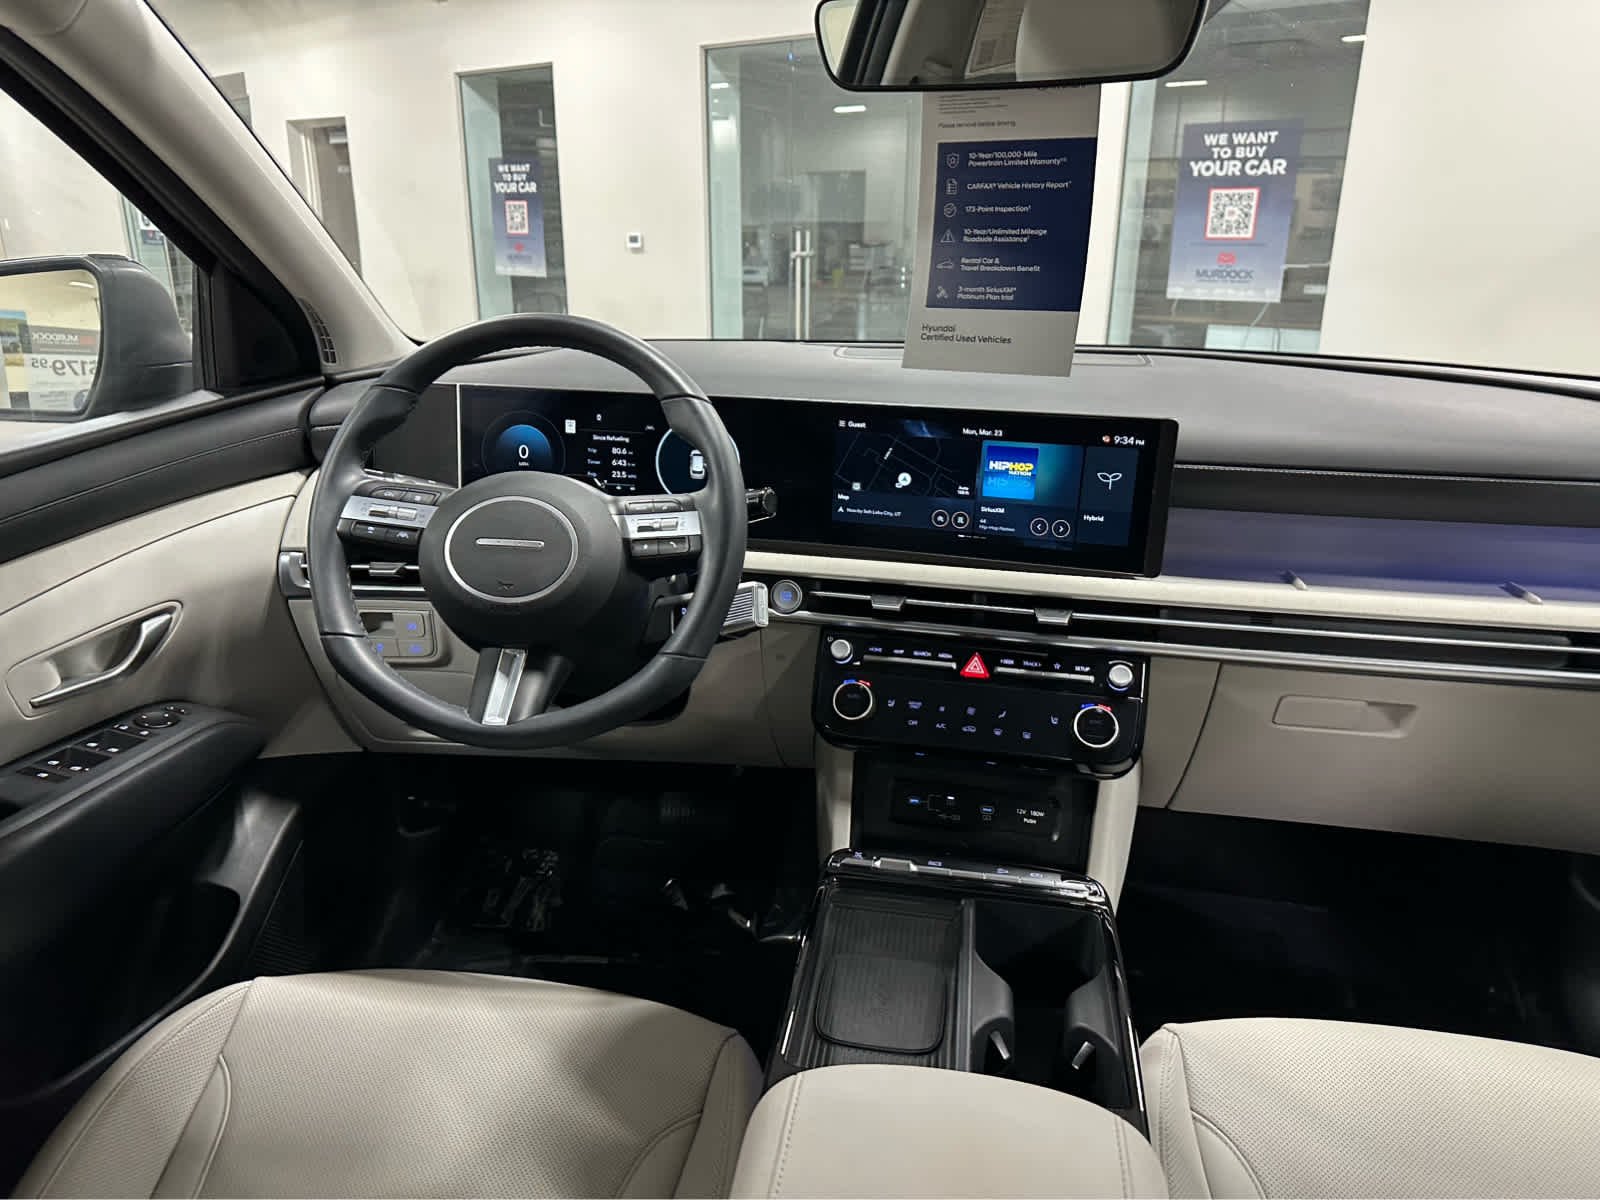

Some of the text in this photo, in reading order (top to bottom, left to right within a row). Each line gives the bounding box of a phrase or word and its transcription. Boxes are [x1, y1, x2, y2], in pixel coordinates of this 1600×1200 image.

[1204, 131, 1279, 146] WE WANT
[1212, 146, 1268, 159] TO BUY
[1189, 159, 1288, 177] YOUR CAR
[494, 181, 538, 193] YOUR CAR
[1020, 227, 1048, 237] Mileage
[980, 264, 1017, 272] Breakdown
[921, 323, 956, 334] Hyundai
[920, 332, 1012, 344] Certified Used Vehicles
[848, 420, 867, 429] Guest
[994, 429, 1003, 437] 23
[1113, 435, 1135, 446] 9:34
[518, 444, 529, 459] 0
[611, 447, 627, 455] 80.6
[611, 470, 627, 478] 23.5
[1083, 514, 1104, 523] Hybrid
